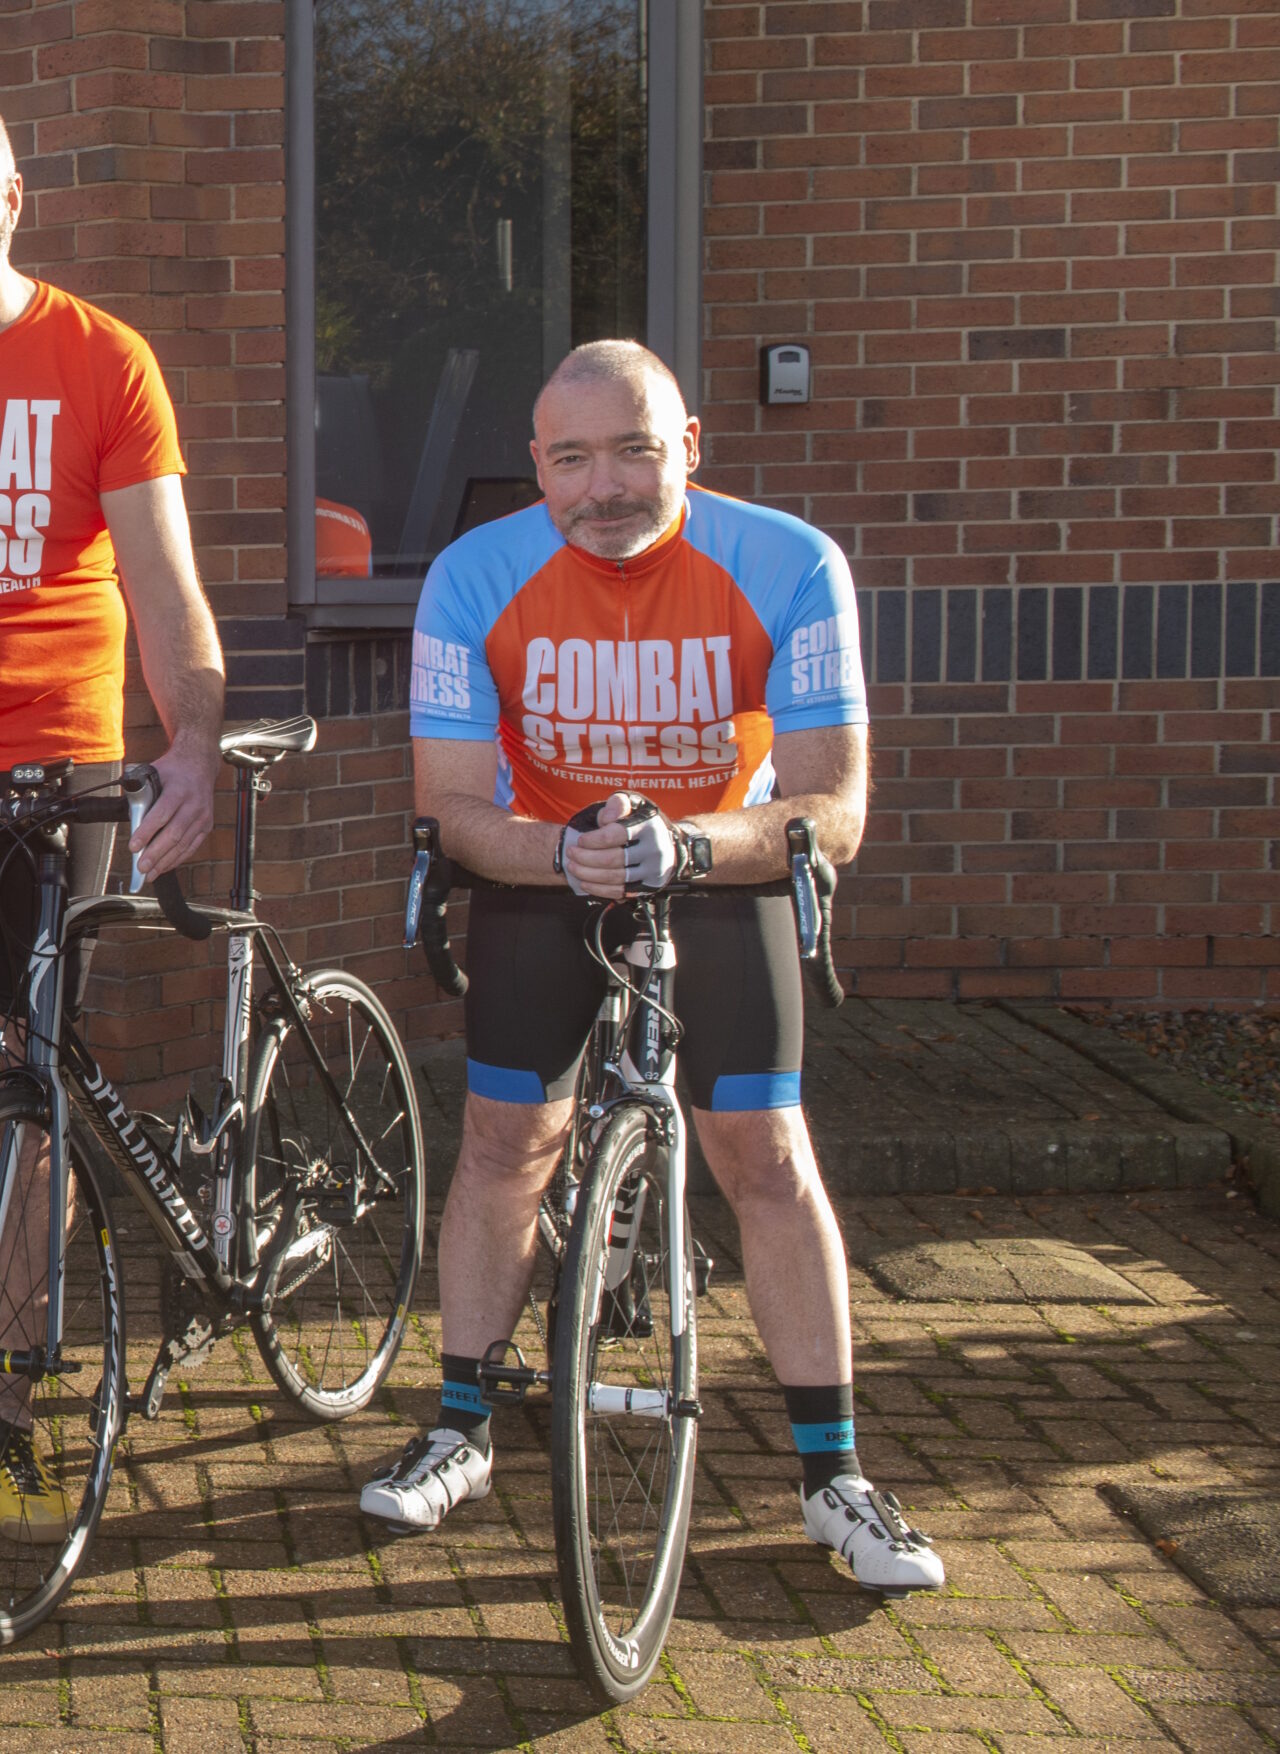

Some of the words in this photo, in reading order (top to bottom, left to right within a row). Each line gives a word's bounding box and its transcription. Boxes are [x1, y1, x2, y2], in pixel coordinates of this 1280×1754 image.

[410, 665, 471, 710] TRESS
[522, 635, 734, 723] COMBAT
[791, 650, 852, 695] STRE
[521, 714, 739, 767] STRESS
[628, 778, 685, 789] MENTAL
[688, 767, 739, 788] HEALTH
[645, 979, 662, 1065] TREK
[84, 1063, 209, 1251] SPECIALIZED
